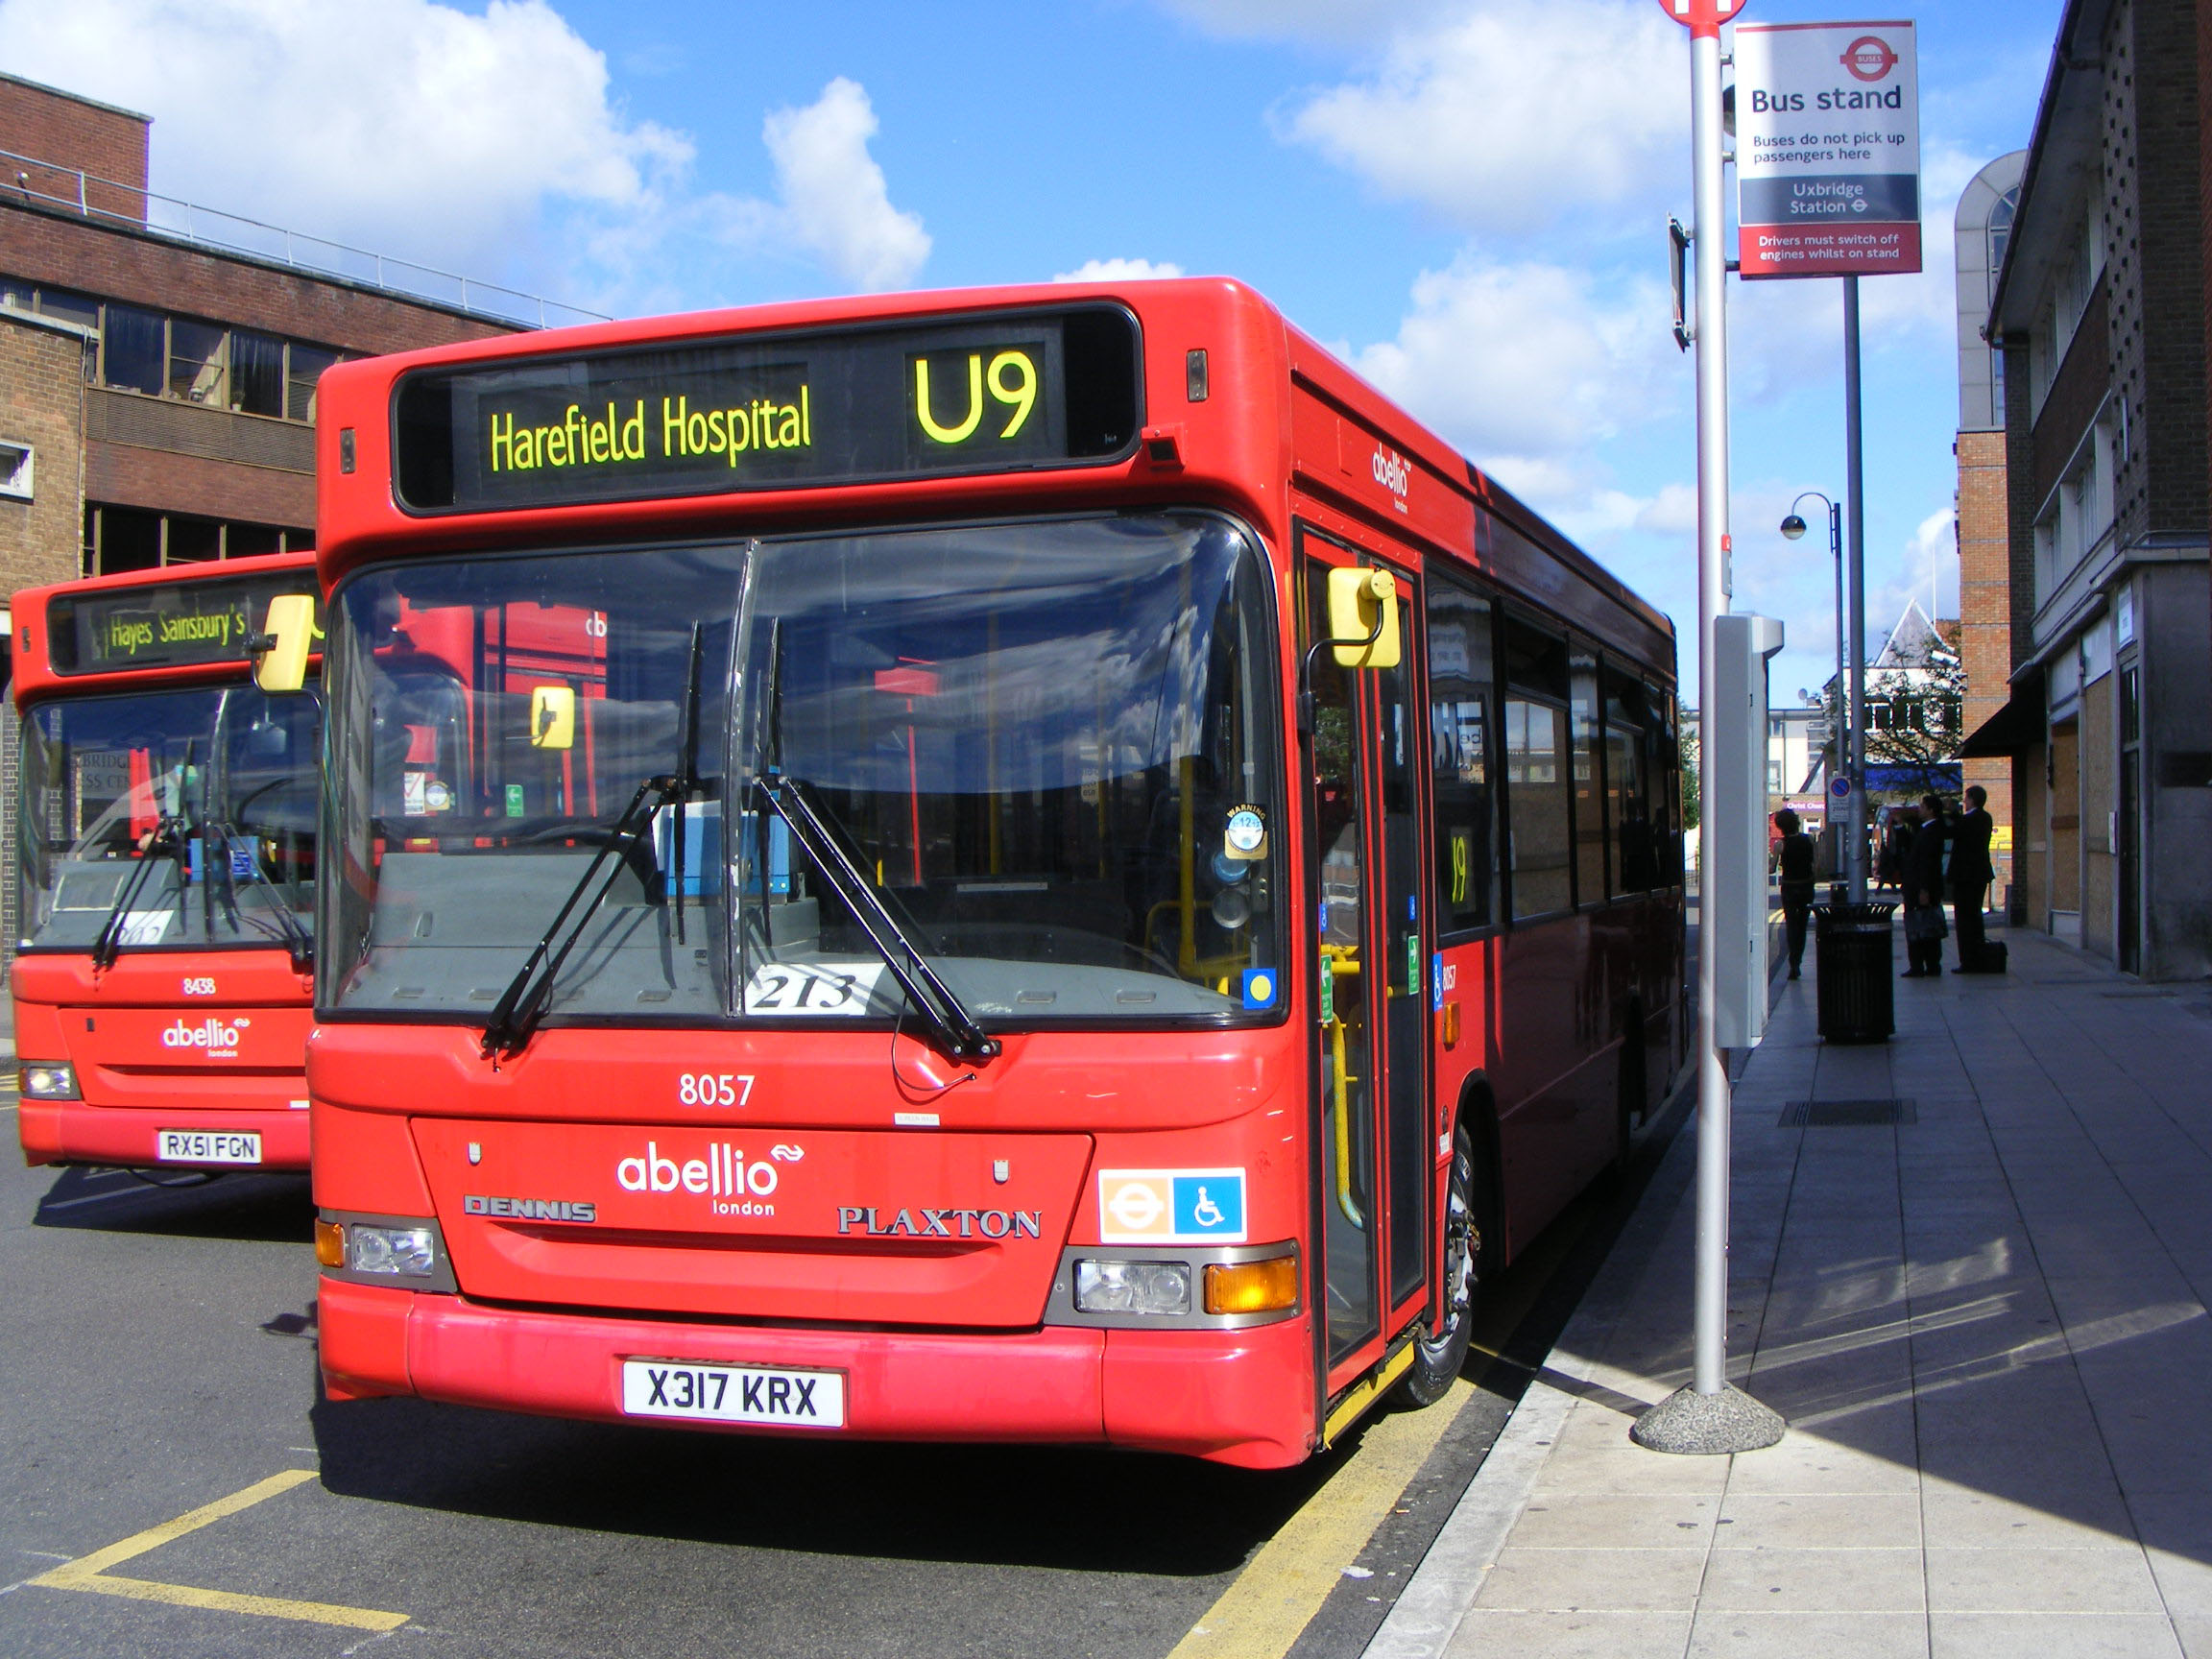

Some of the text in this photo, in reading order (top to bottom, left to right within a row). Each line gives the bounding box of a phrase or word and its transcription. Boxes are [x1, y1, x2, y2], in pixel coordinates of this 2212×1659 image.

[1858, 54, 1882, 63] BUSES
[1752, 84, 1902, 113] Bus stand
[1753, 132, 1905, 148] Buses do not pick up
[1754, 148, 1871, 165] passengers here
[1793, 182, 1863, 200] Uxbridge
[1791, 200, 1846, 214] Station
[1759, 233, 1900, 247] Drivers must switch off
[1760, 247, 1900, 262] engines whilst on stand
[491, 351, 1038, 472] Harefield Hospital U9
[1373, 442, 1407, 497] abellio
[111, 601, 246, 656] Hayes Sainsbury's
[1227, 804, 1266, 821] WARNING
[183, 977, 216, 995] 8438
[1442, 964, 1456, 991] 8057
[752, 974, 856, 1008] 213
[162, 1018, 239, 1047] abellio
[207, 1049, 238, 1058] london
[679, 1072, 756, 1106] 8057
[168, 1135, 254, 1158] RX51 FGN
[617, 1141, 779, 1197] abellio
[464, 1194, 598, 1224] DENNIS
[712, 1198, 775, 1216] london
[837, 1205, 1043, 1239] PLAXTON
[647, 1369, 817, 1416] X317 KRX
